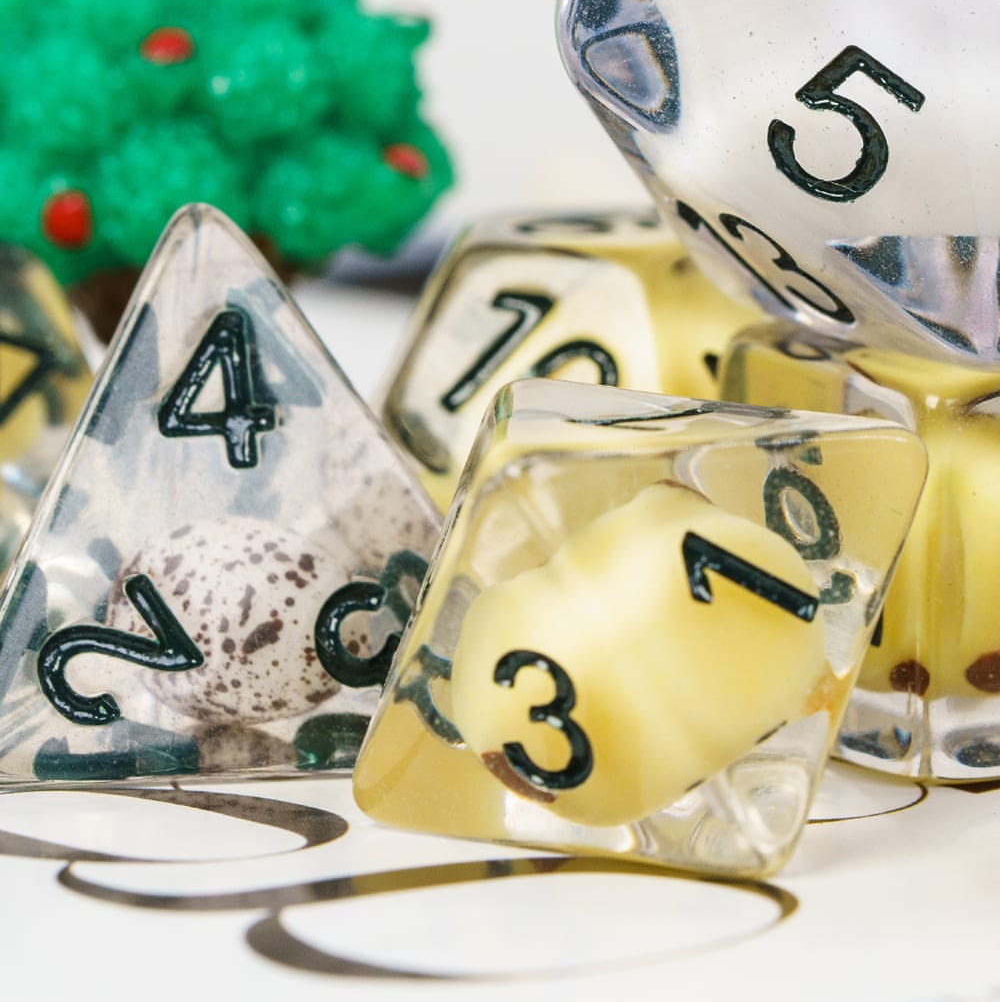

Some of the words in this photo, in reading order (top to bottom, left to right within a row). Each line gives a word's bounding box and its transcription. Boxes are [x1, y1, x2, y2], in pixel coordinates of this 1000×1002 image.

[766, 44, 926, 204] 5
[675, 199, 856, 326] 13
[158, 307, 279, 470] 4
[37, 573, 204, 727] 2
[680, 530, 821, 623] 1
[492, 649, 595, 791] 3
